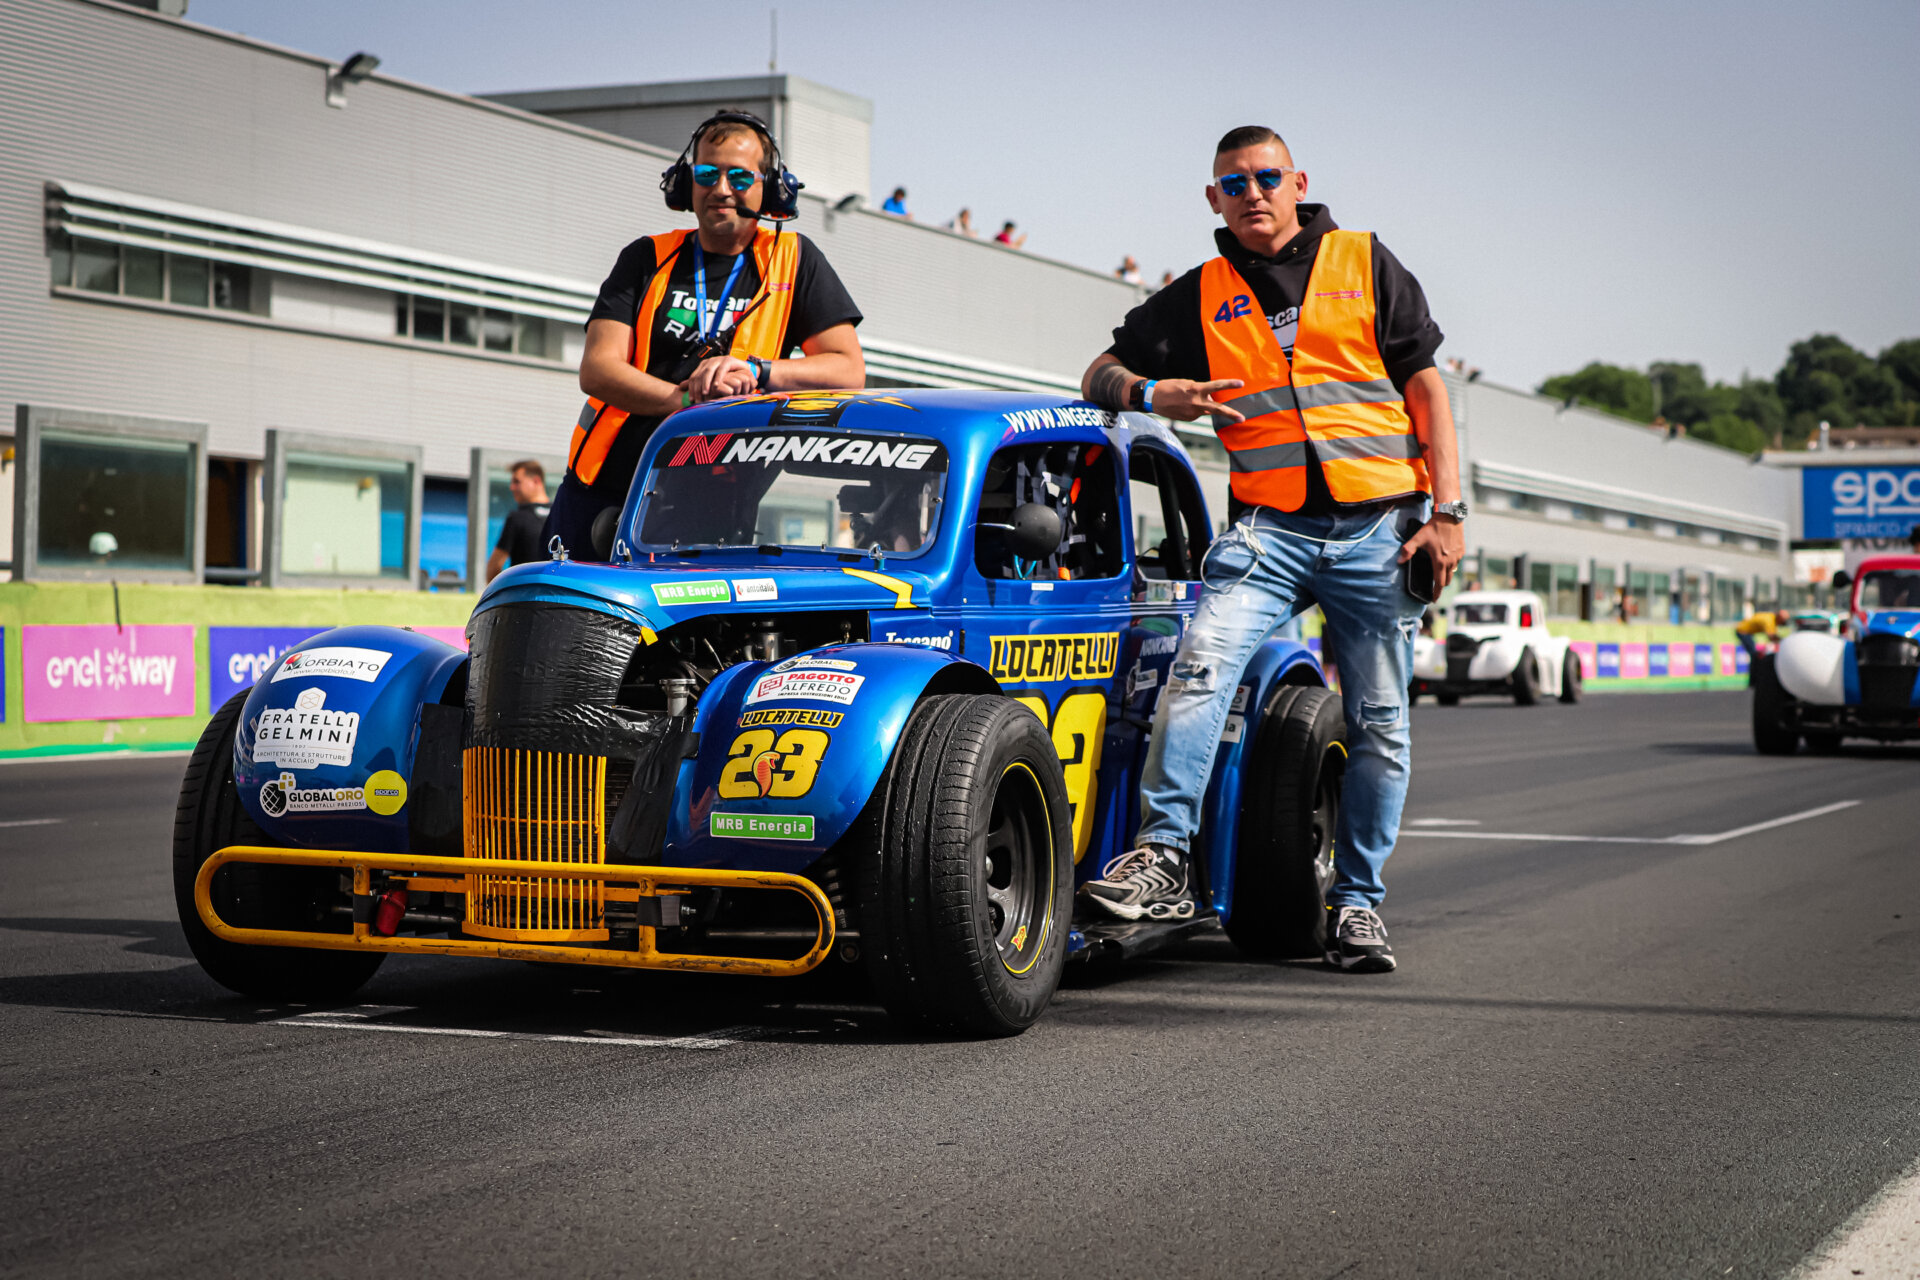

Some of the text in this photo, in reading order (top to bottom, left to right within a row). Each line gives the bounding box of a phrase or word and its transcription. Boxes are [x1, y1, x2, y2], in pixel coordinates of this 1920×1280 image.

[1214, 294, 1252, 323] 42
[722, 435, 938, 470] NANKANG
[659, 584, 726, 598] MRB Energia
[800, 660, 854, 668] GLOBALORO
[989, 633, 1120, 682] LOCATELLI
[46, 648, 176, 695] enel way
[787, 673, 856, 684] PAGOTTO
[780, 683, 851, 695] ALFREDO
[800, 691, 833, 699] COSTRUZIONI
[262, 713, 354, 728] FRATELLI
[742, 709, 843, 728] LOCATELLI
[259, 728, 351, 744] GELMINI
[308, 752, 347, 761] STRUTTURE
[718, 728, 832, 800] 23
[288, 790, 364, 802] GLOBALORO
[716, 817, 807, 833] MRB Energia
